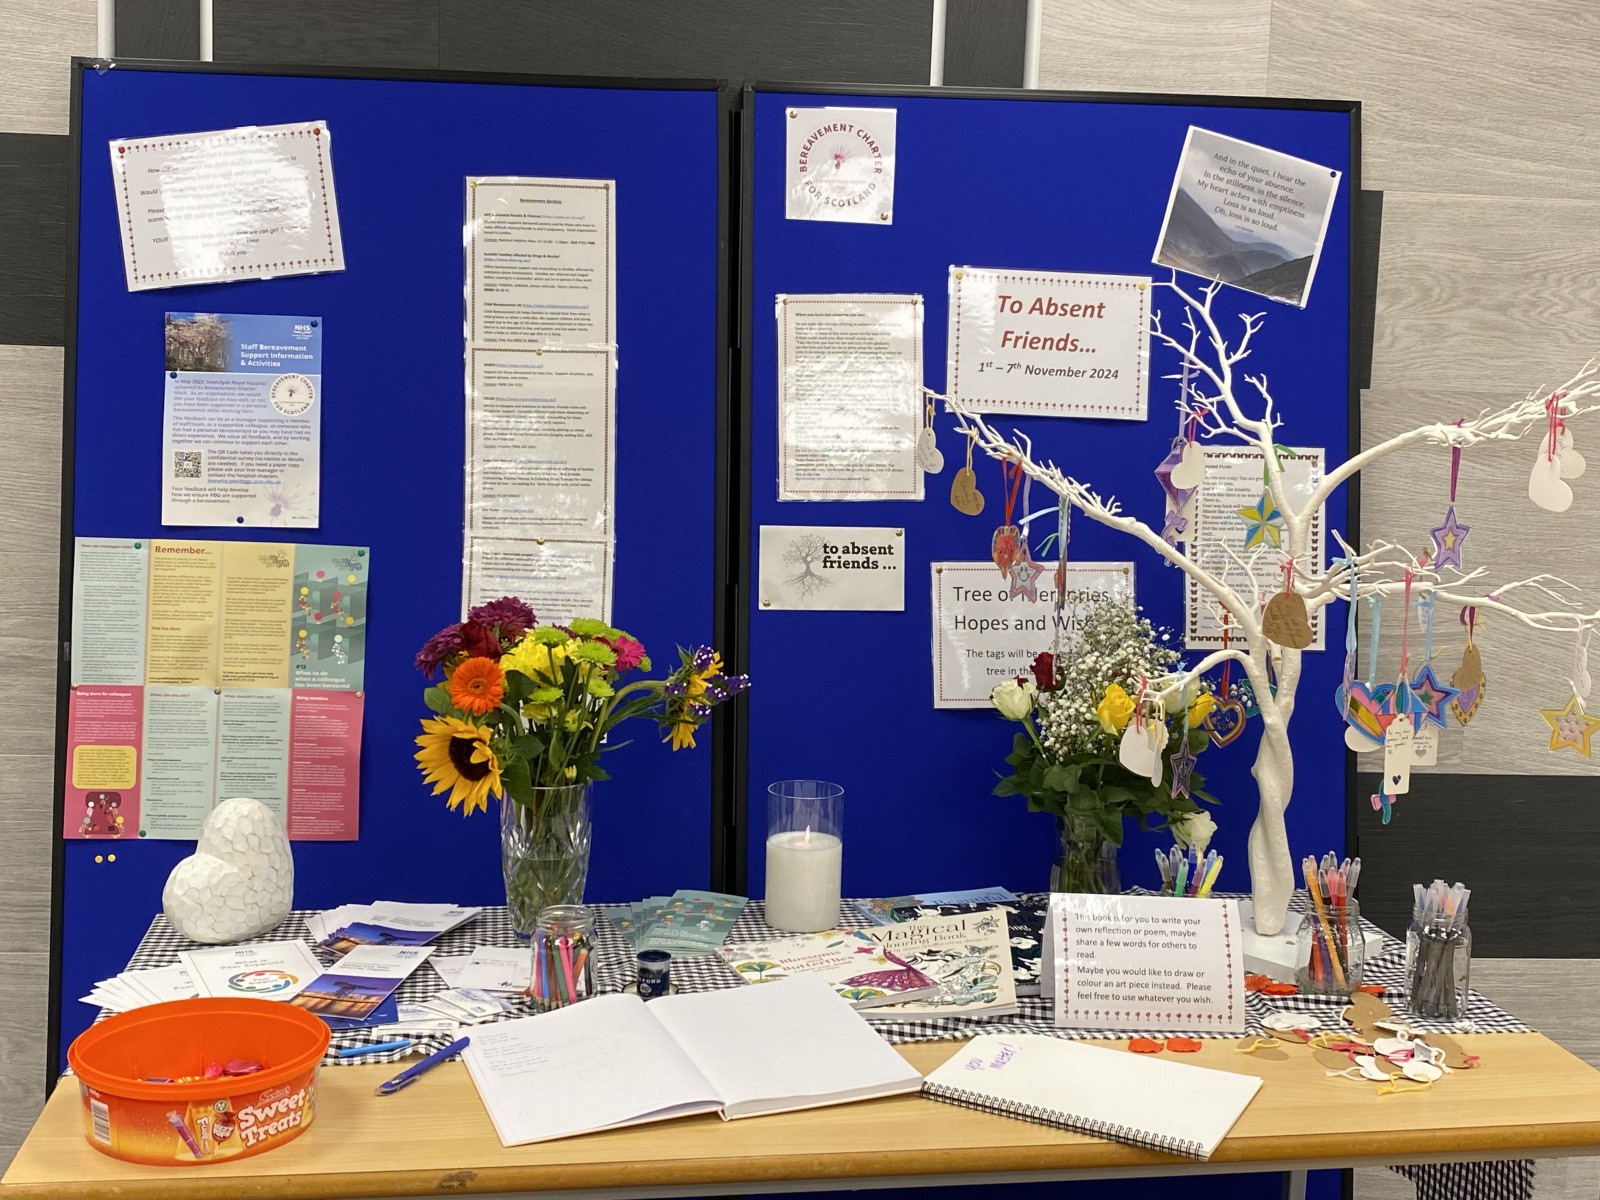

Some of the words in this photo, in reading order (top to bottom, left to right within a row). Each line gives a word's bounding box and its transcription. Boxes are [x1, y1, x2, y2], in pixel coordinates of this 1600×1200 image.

[799, 123, 854, 173] BEREAVEMENT
[856, 129, 882, 174] CHARTER
[1213, 153, 1228, 162] And
[1238, 160, 1250, 169] the
[1251, 165, 1270, 176] quiet,
[1277, 172, 1293, 182] hear
[1295, 178, 1306, 186] the
[1220, 166, 1236, 175] echo
[1247, 175, 1264, 184] your
[1265, 180, 1294, 194] absence.
[804, 180, 822, 200] FOR
[824, 182, 876, 208] SCOTLAND
[1197, 180, 1209, 189] My
[1210, 182, 1228, 194] heart
[1230, 191, 1250, 201] aches
[1252, 198, 1267, 206] with
[1213, 173, 1224, 182] the
[1226, 179, 1256, 193] stillness,
[1266, 190, 1278, 199] the
[1279, 195, 1305, 209] silence,
[1223, 198, 1239, 208] Loss
[1215, 206, 1226, 216] Oh,
[1229, 211, 1242, 220] loss
[1261, 220, 1278, 231] loud.
[998, 295, 1023, 313] To
[1028, 297, 1106, 319] Absent
[1001, 330, 1096, 353] Friends...
[1025, 365, 1087, 378] November
[1090, 369, 1119, 379] 2024
[822, 543, 839, 554] to
[842, 542, 894, 555] absent
[822, 555, 879, 569] friends
[953, 586, 992, 602] Tree
[955, 615, 1009, 634] Hopes
[1015, 615, 1046, 630] and
[986, 650, 1005, 660] tags
[1008, 649, 1024, 658] will
[1027, 650, 1038, 658] be
[1008, 667, 1017, 675] in
[1020, 667, 1035, 675] the
[871, 920, 966, 942] Magical
[934, 932, 966, 941] Book
[1171, 930, 1197, 939] maybe
[779, 951, 841, 964] Blossoms
[782, 956, 854, 971] Butterflies
[1077, 966, 1104, 975] Maybe
[1174, 969, 1194, 977] draw
[1129, 981, 1150, 989] piece
[1151, 982, 1182, 990] instead.
[1077, 991, 1092, 1000] feel
[1094, 992, 1110, 1000] free
[1193, 996, 1213, 1004] wish.
[238, 1088, 306, 1130] Sweet
[240, 1110, 302, 1147] Treats
